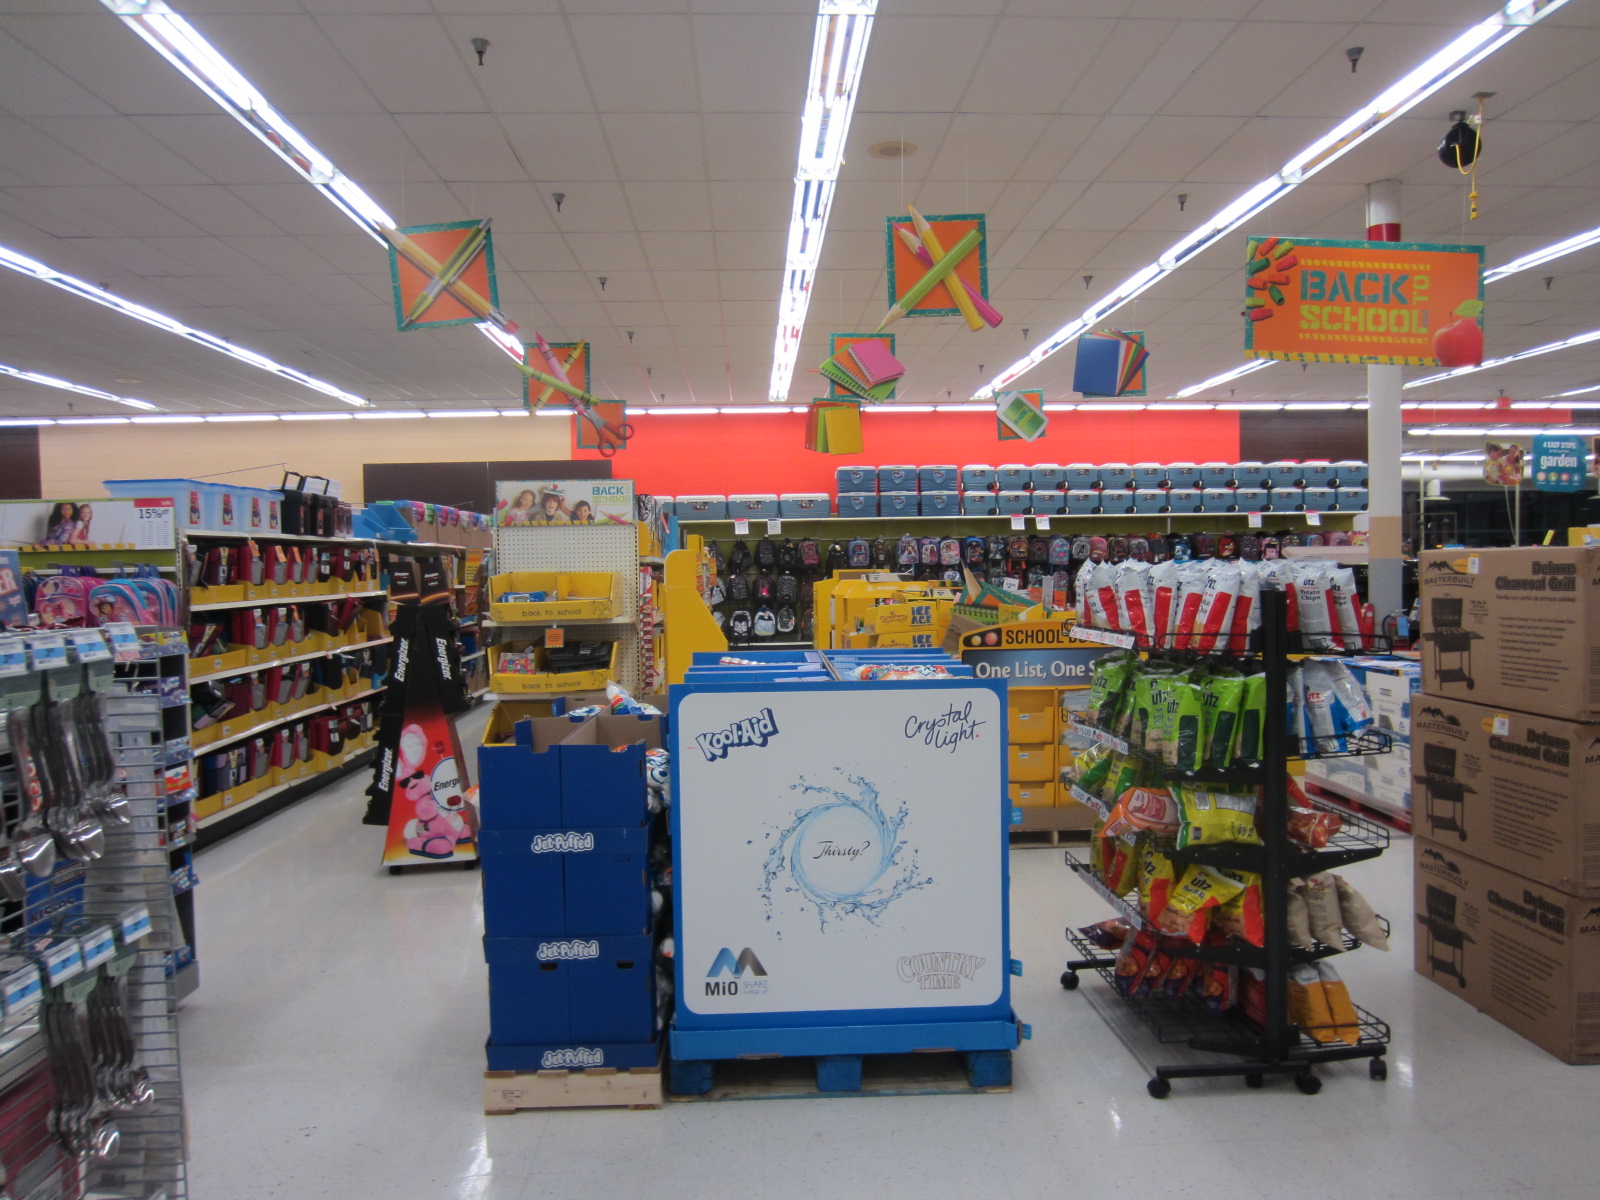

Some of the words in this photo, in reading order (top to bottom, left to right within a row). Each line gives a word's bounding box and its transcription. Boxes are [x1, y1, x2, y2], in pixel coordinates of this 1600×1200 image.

[1300, 269, 1410, 305] BACK
[1412, 275, 1430, 306] TO
[1299, 304, 1429, 334] SCHOOL
[1547, 441, 1560, 449] EASY
[1560, 441, 1577, 450] STEPS
[1540, 453, 1578, 470] garden
[592, 486, 625, 496] BACK
[592, 495, 631, 504] SCHOOL
[138, 508, 162, 519] 15%
[1531, 560, 1577, 576] Deluxe
[1423, 575, 1476, 586] MASTERBUILT
[1494, 575, 1547, 592] Charcoal
[1547, 576, 1577, 592] Grill
[1301, 594, 1322, 602] Chips
[557, 608, 582, 616] school
[911, 605, 932, 616] ICE
[911, 615, 932, 625] AGE
[912, 634, 932, 644] ICE
[1005, 628, 1065, 645] SCHOOL
[394, 637, 410, 683] Energizer
[436, 637, 453, 680] Energizer
[975, 661, 1011, 679] One
[1014, 660, 1048, 679] List,
[1050, 660, 1087, 677] One
[556, 680, 581, 688] school
[904, 700, 972, 746] Crystal
[1415, 720, 1470, 739] MASTERBUILT
[695, 707, 780, 763] Kool-Aid
[1525, 727, 1571, 751] Deluxe
[1488, 735, 1541, 761] Charcoal
[1541, 748, 1570, 768] Grill
[378, 747, 394, 793] Energizer
[531, 831, 595, 854] Jet-Puffed
[812, 840, 871, 862] Thirsty?
[1418, 861, 1470, 887] MASTERBUILT
[536, 939, 600, 961] Jet-Puffed
[896, 951, 986, 984] COUNTRY
[743, 980, 769, 989] SHAKE
[918, 973, 961, 990] TIME
[541, 1047, 604, 1069] Jet-Puffed
